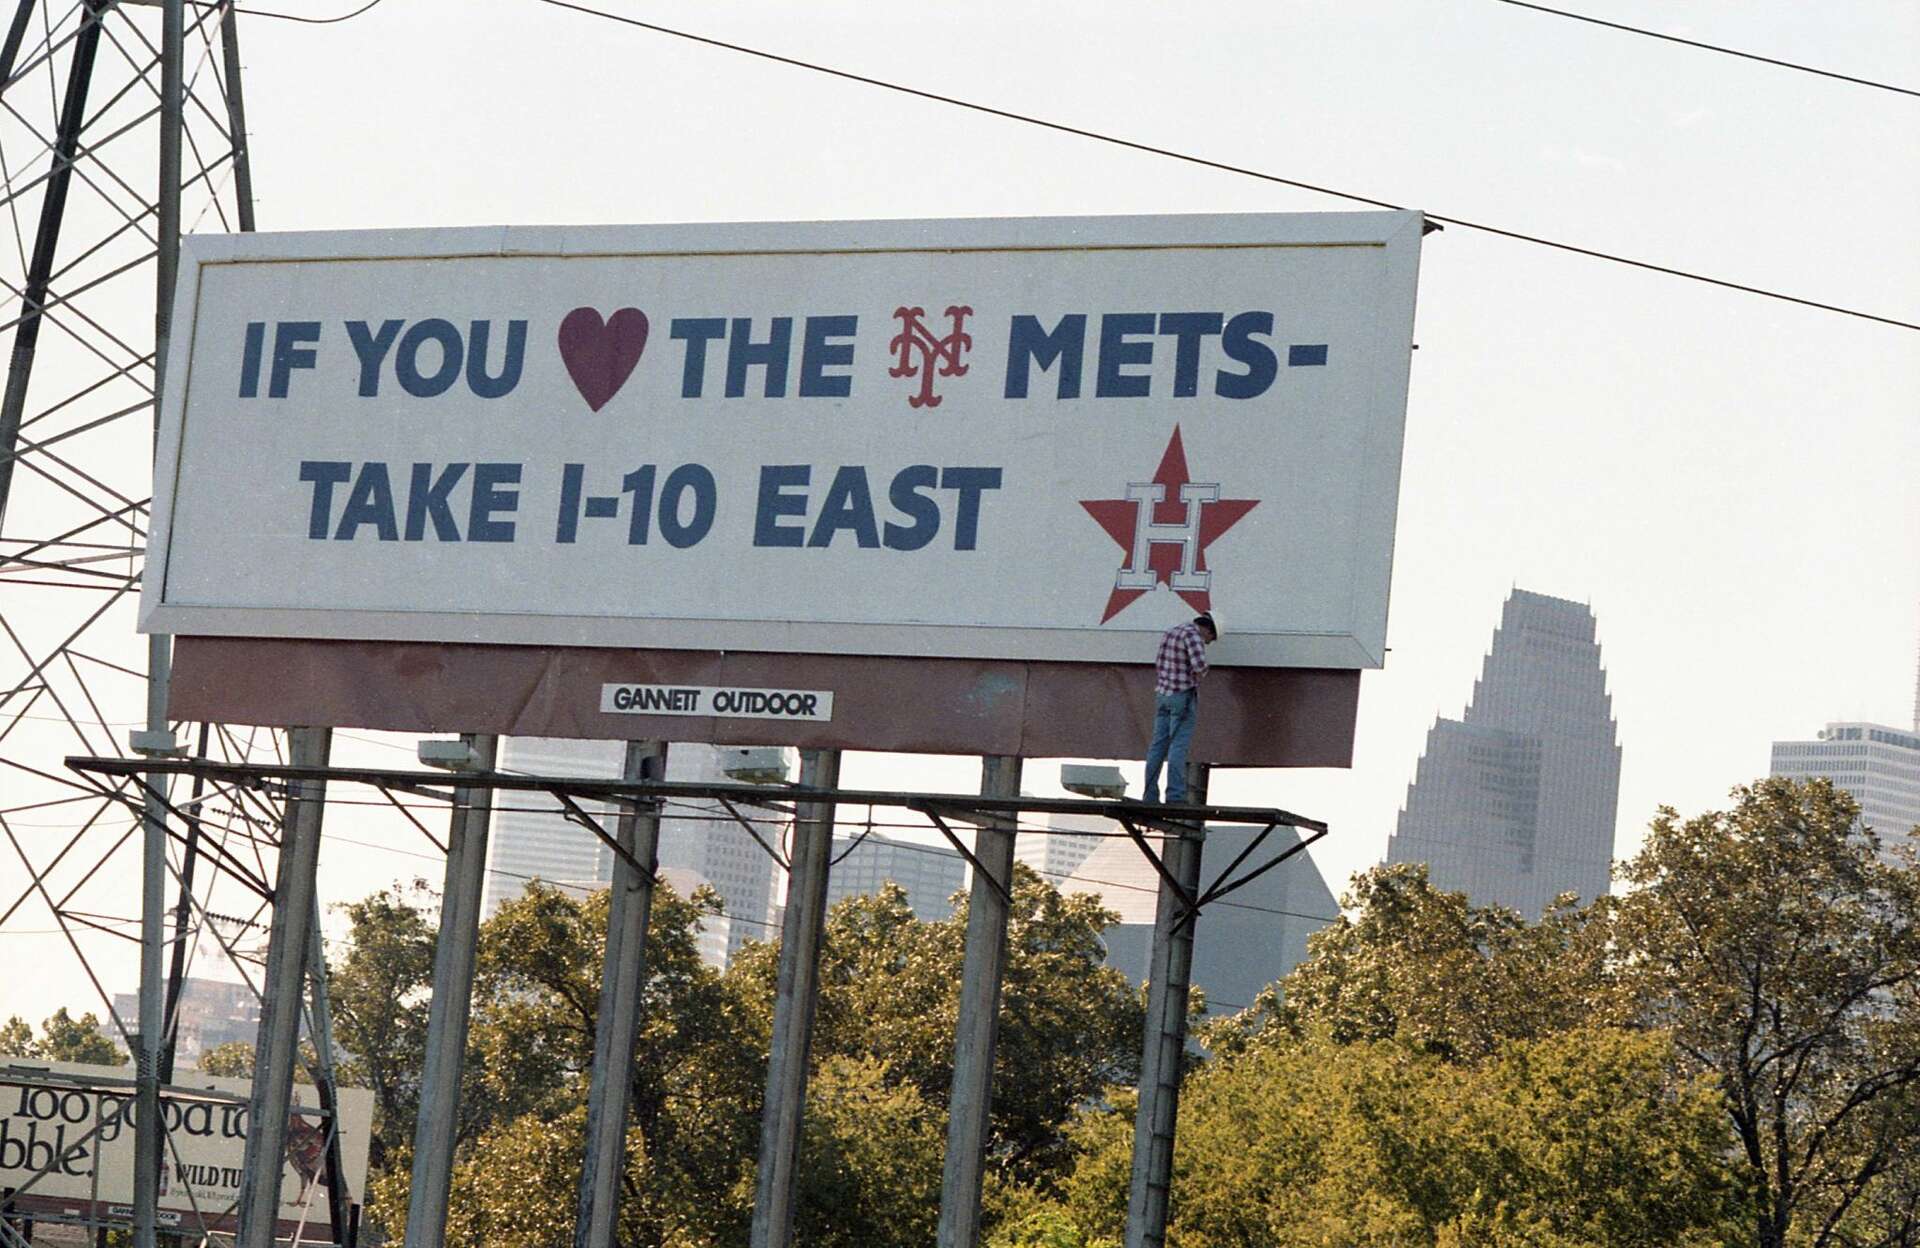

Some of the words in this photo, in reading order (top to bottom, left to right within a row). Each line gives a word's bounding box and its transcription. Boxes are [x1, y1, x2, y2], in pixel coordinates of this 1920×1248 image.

[238, 321, 321, 399] IF
[345, 318, 528, 399] YOU
[670, 315, 858, 399] THE
[1003, 310, 1328, 400] METS-
[299, 461, 523, 543] TAKE
[555, 462, 717, 549] I-10
[752, 464, 1003, 552] EAST
[1116, 481, 1221, 592] H
[613, 687, 701, 712] GANNETT
[712, 690, 817, 716] OUTDOOR
[175, 1163, 220, 1187] WILD
